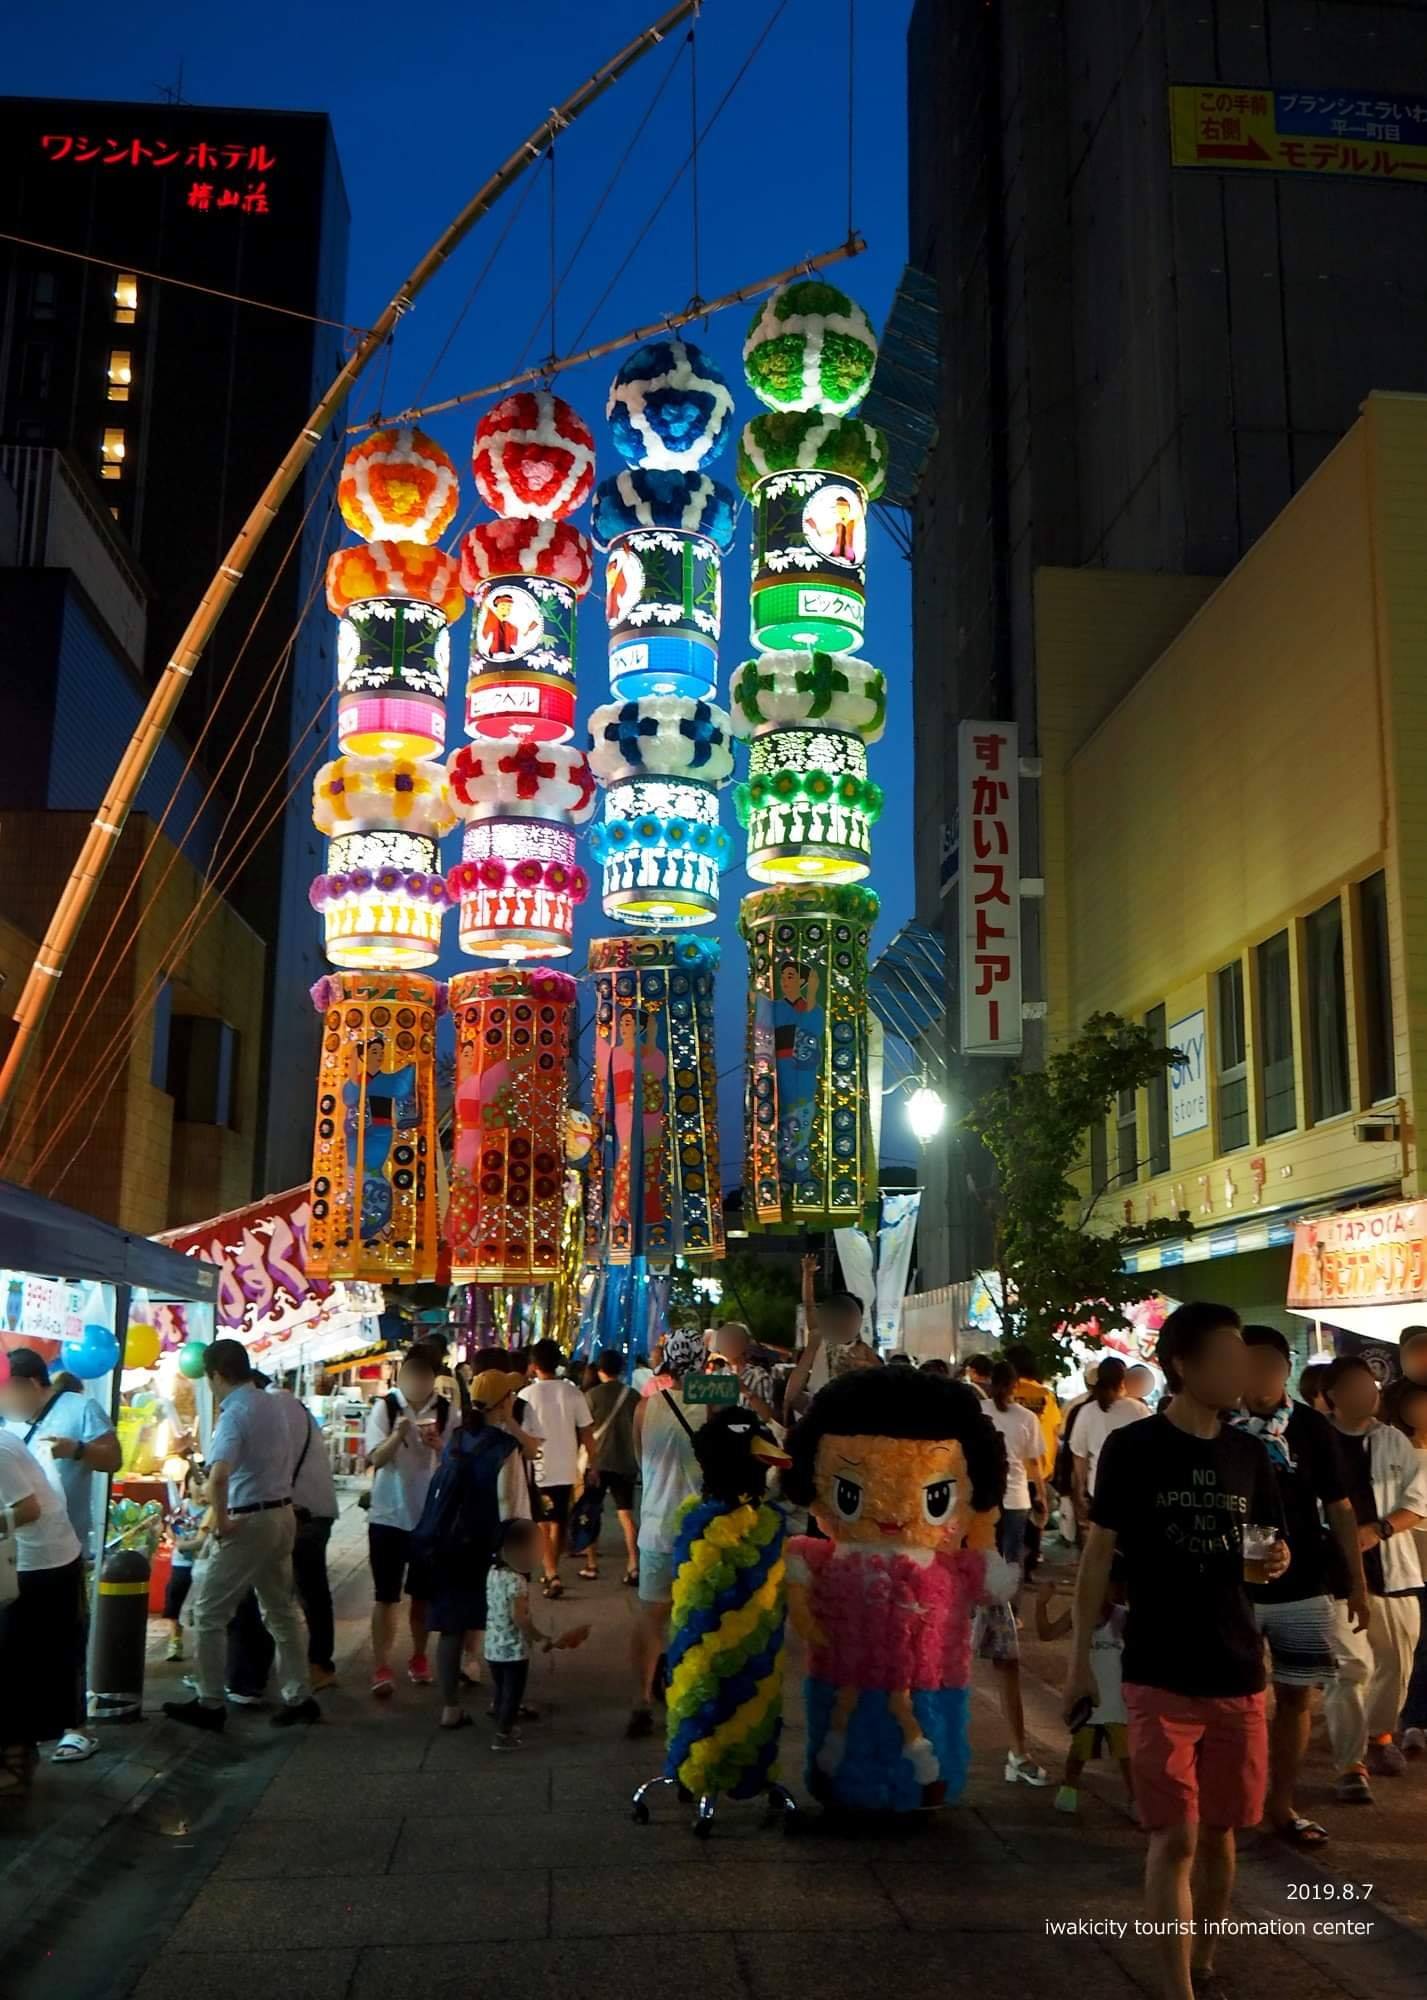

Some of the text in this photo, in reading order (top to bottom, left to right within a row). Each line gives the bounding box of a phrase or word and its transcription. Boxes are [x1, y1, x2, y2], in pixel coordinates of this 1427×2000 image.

[1200, 92, 1267, 117] この手前
[1200, 117, 1241, 141] 右側
[1279, 141, 1427, 176] モデルルー
[972, 733, 1011, 1041] すかいストアー
[1171, 1033, 1204, 1090] SKY
[1175, 1095, 1204, 1122] store
[1336, 1211, 1405, 1241] TAPOCA
[1192, 1468, 1216, 1486] NO
[1154, 1490, 1248, 1513] APOLOGIES
[1193, 1514, 1216, 1531] NO
